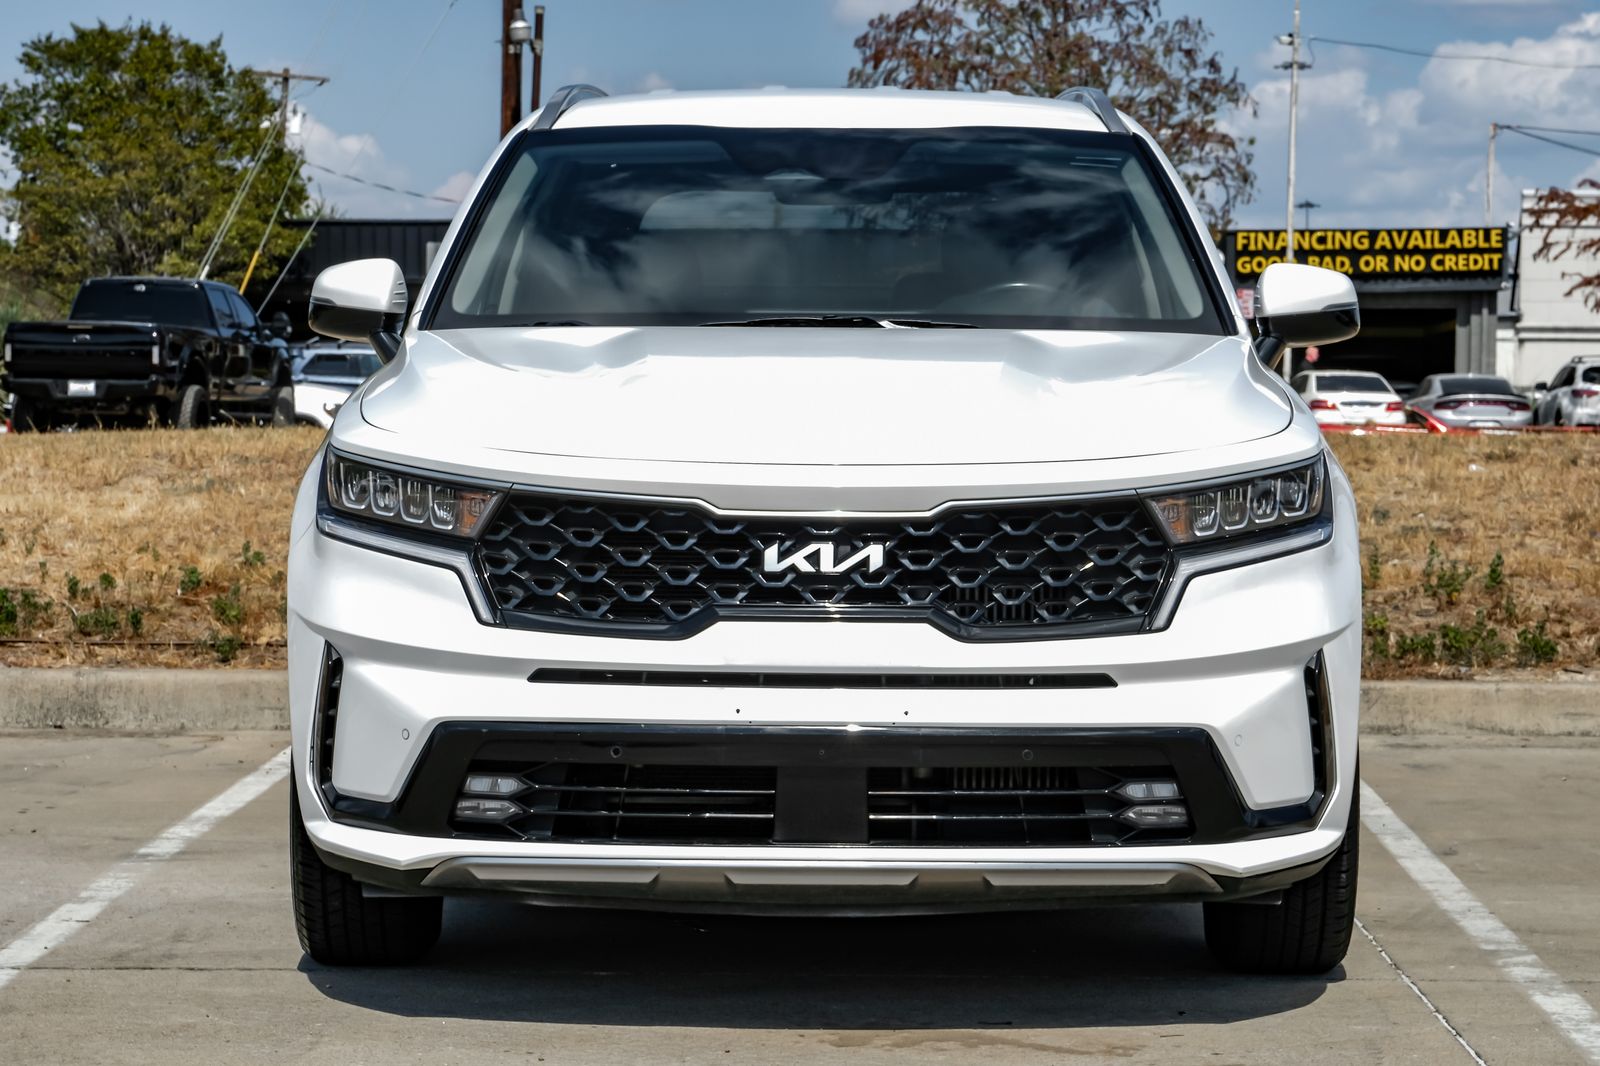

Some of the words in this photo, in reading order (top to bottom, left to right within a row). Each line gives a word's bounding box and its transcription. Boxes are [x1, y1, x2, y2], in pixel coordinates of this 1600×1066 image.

[1236, 231, 1370, 251] FINANCING
[1374, 229, 1503, 250] AVAILABLE
[1359, 255, 1389, 272] OR
[1394, 254, 1427, 272] NO
[1430, 253, 1503, 272] CREDIT
[763, 541, 884, 574] KIA
